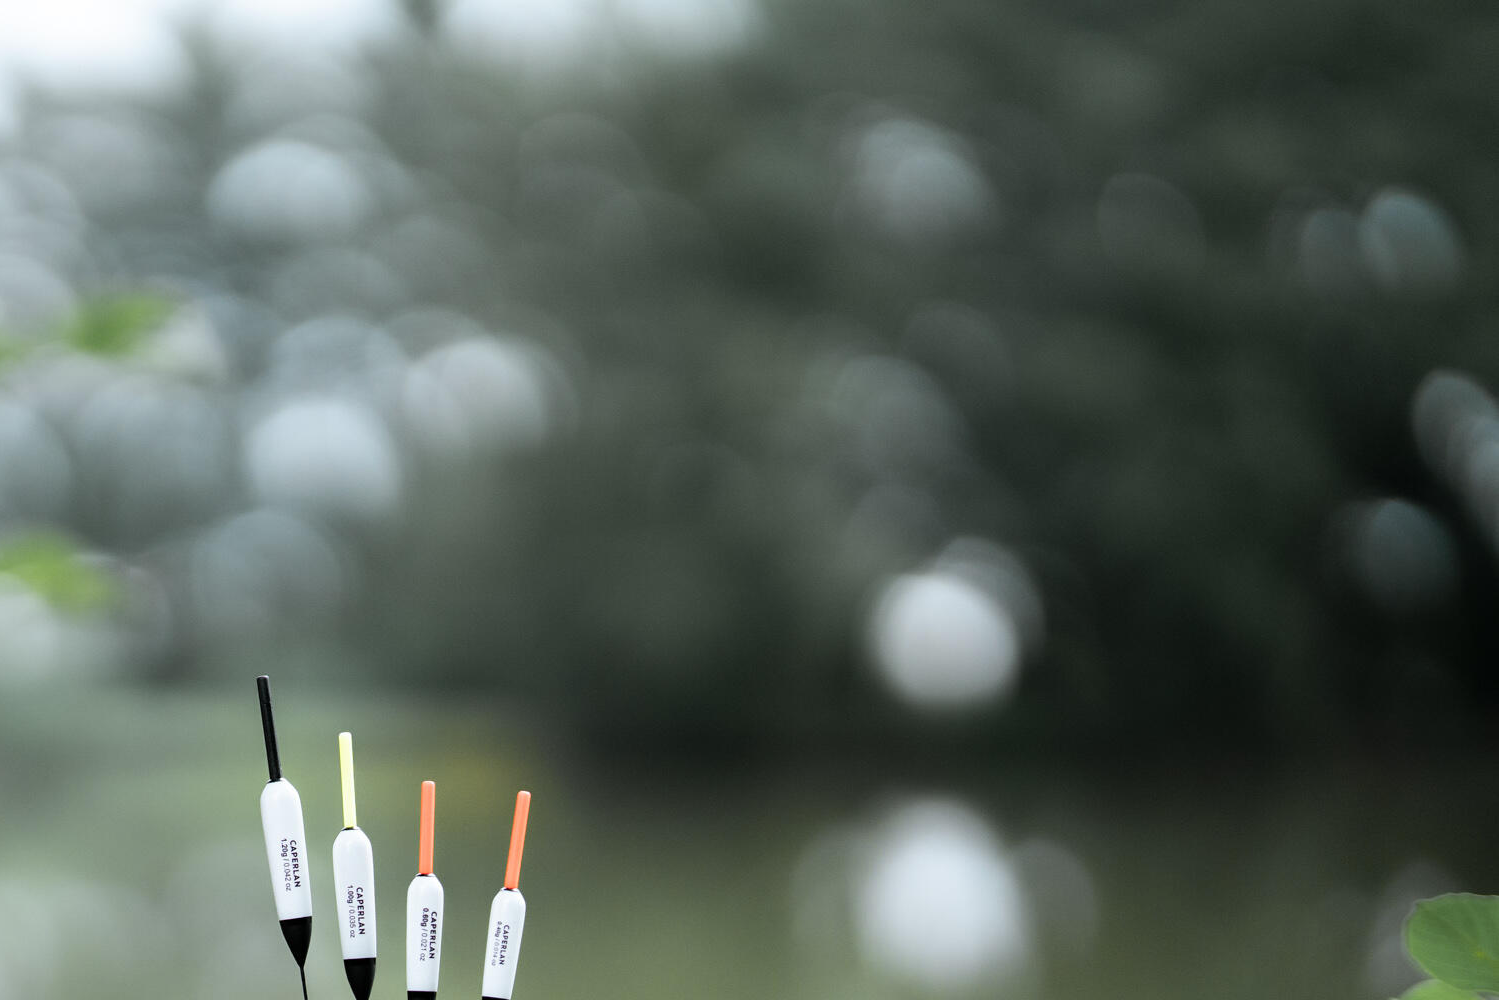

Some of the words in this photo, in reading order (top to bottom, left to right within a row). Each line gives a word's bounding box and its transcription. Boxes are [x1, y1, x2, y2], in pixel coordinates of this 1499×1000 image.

[281, 838, 289, 858] 1.20g
[290, 840, 301, 888] CAPERLAN
[356, 886, 365, 935] CAPERLAN
[420, 907, 429, 927] 0.60g
[429, 911, 438, 959] CAPERLAN
[499, 924, 510, 965] CAPERLAN
